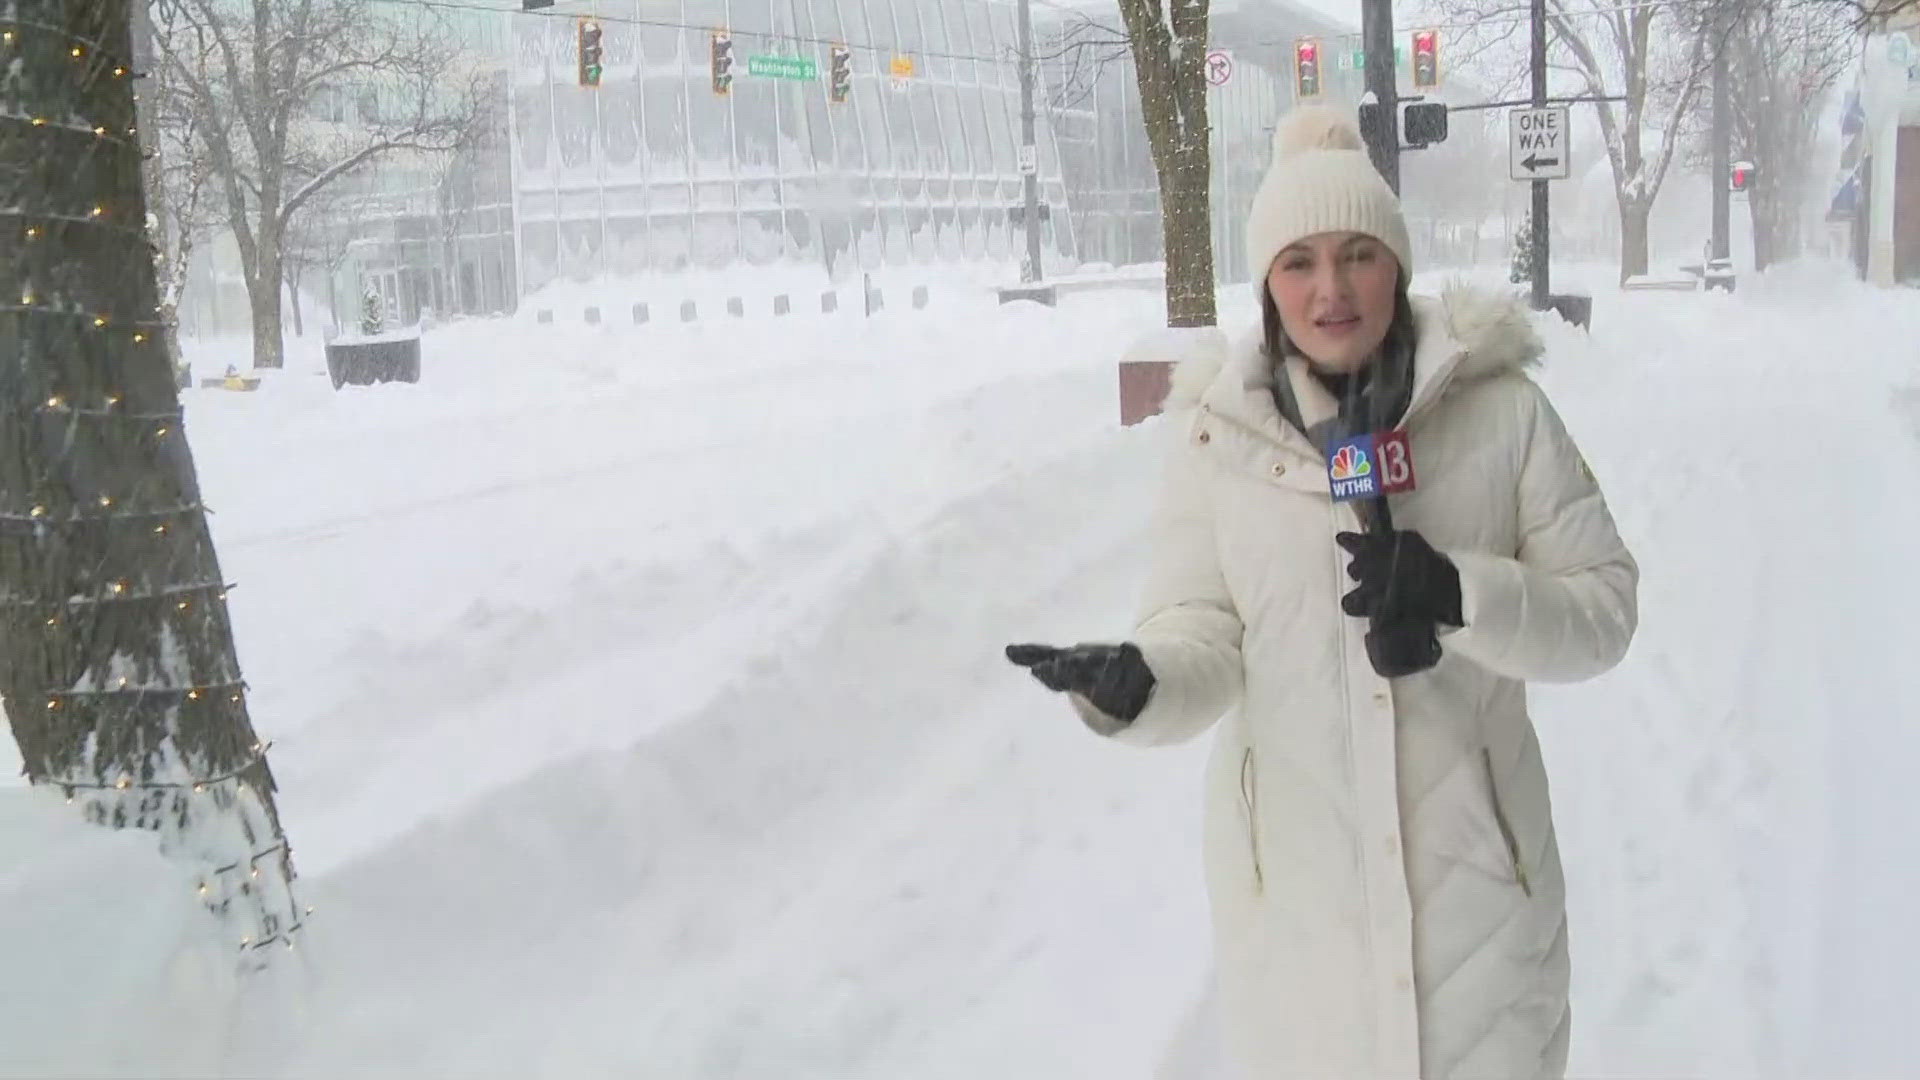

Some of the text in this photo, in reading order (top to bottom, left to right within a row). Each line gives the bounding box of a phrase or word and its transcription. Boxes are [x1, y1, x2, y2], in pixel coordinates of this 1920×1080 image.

[751, 61, 801, 77] Washington
[1520, 113, 1557, 130] ONE
[1519, 131, 1558, 149] WAY
[1376, 440, 1409, 486] 13
[1332, 477, 1373, 497] WTHR
